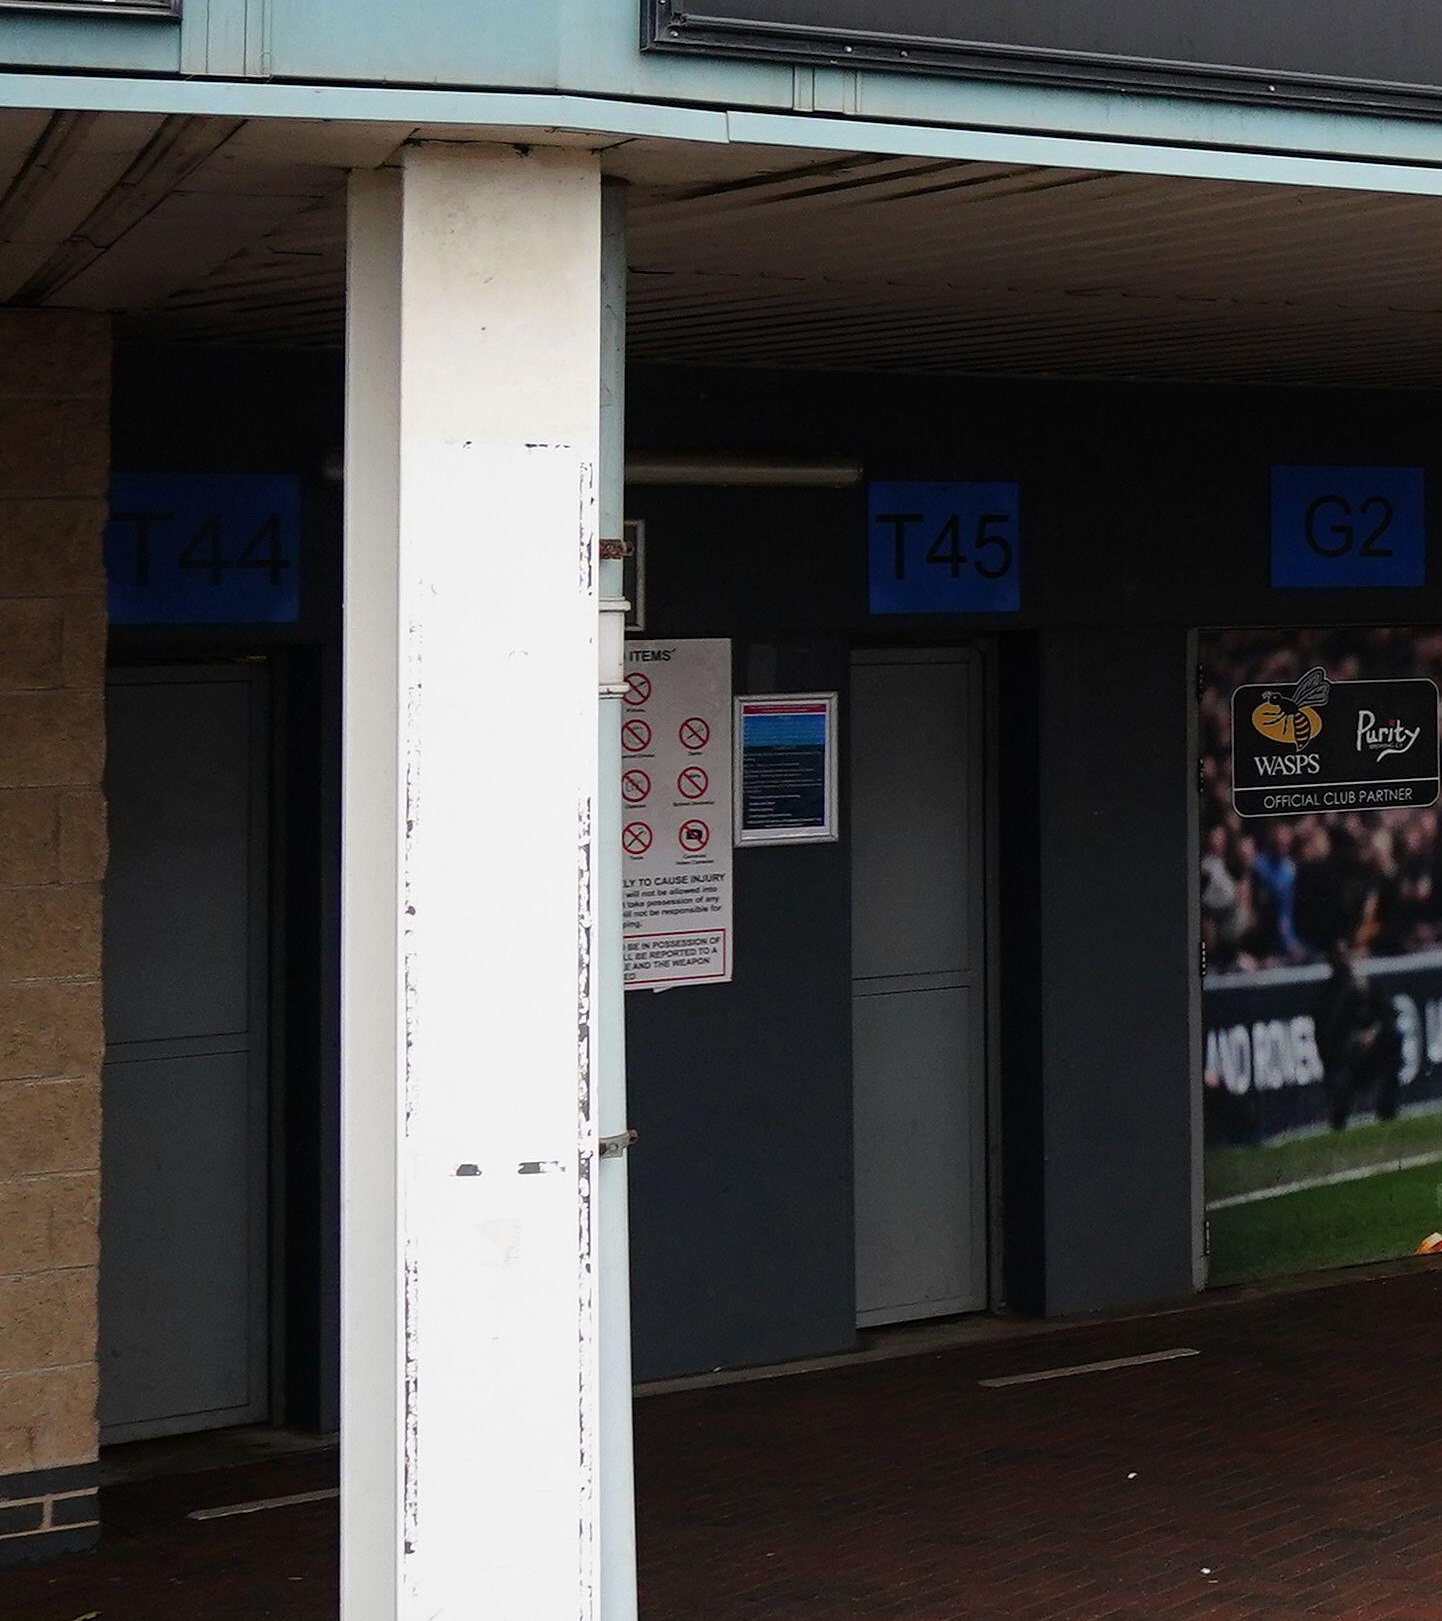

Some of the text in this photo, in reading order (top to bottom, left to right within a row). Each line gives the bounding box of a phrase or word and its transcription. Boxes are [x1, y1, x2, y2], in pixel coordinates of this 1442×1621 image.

[1304, 494, 1393, 558] G2
[111, 512, 291, 587] T44
[875, 513, 1012, 580] T45
[629, 650, 671, 662] ITEMS
[1356, 709, 1421, 763] Purity
[1253, 753, 1320, 776] WASPS
[1263, 787, 1413, 810] OFFICIAL CLUB PARTNER
[639, 877, 652, 887] TO
[655, 874, 689, 886] CAUSE
[690, 872, 726, 883] INJURY
